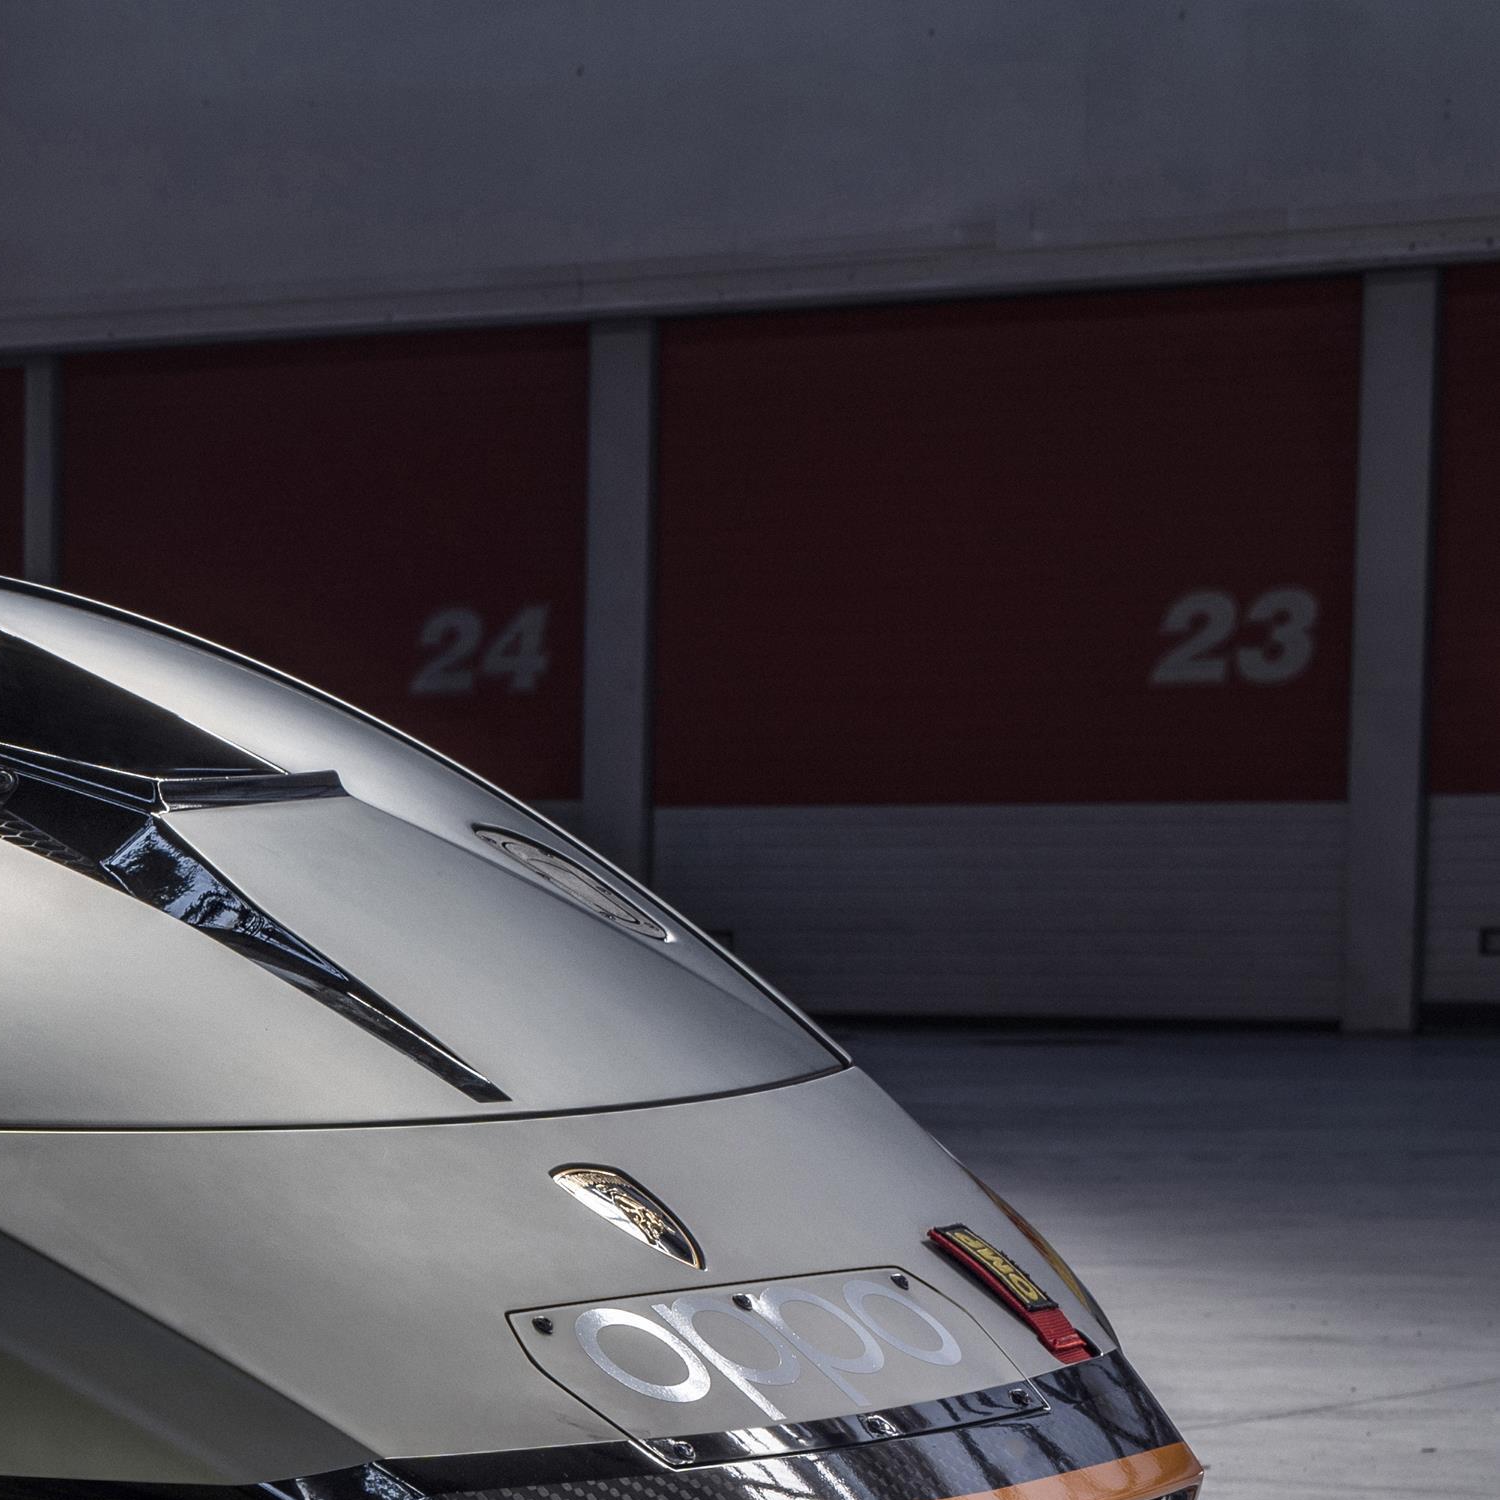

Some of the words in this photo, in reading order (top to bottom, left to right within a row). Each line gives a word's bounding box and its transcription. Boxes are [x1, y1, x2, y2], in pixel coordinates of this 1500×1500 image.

[412, 606, 549, 692] 24
[1151, 590, 1318, 684] 23
[953, 1231, 1040, 1302] OMP
[574, 1279, 963, 1422] oppo
